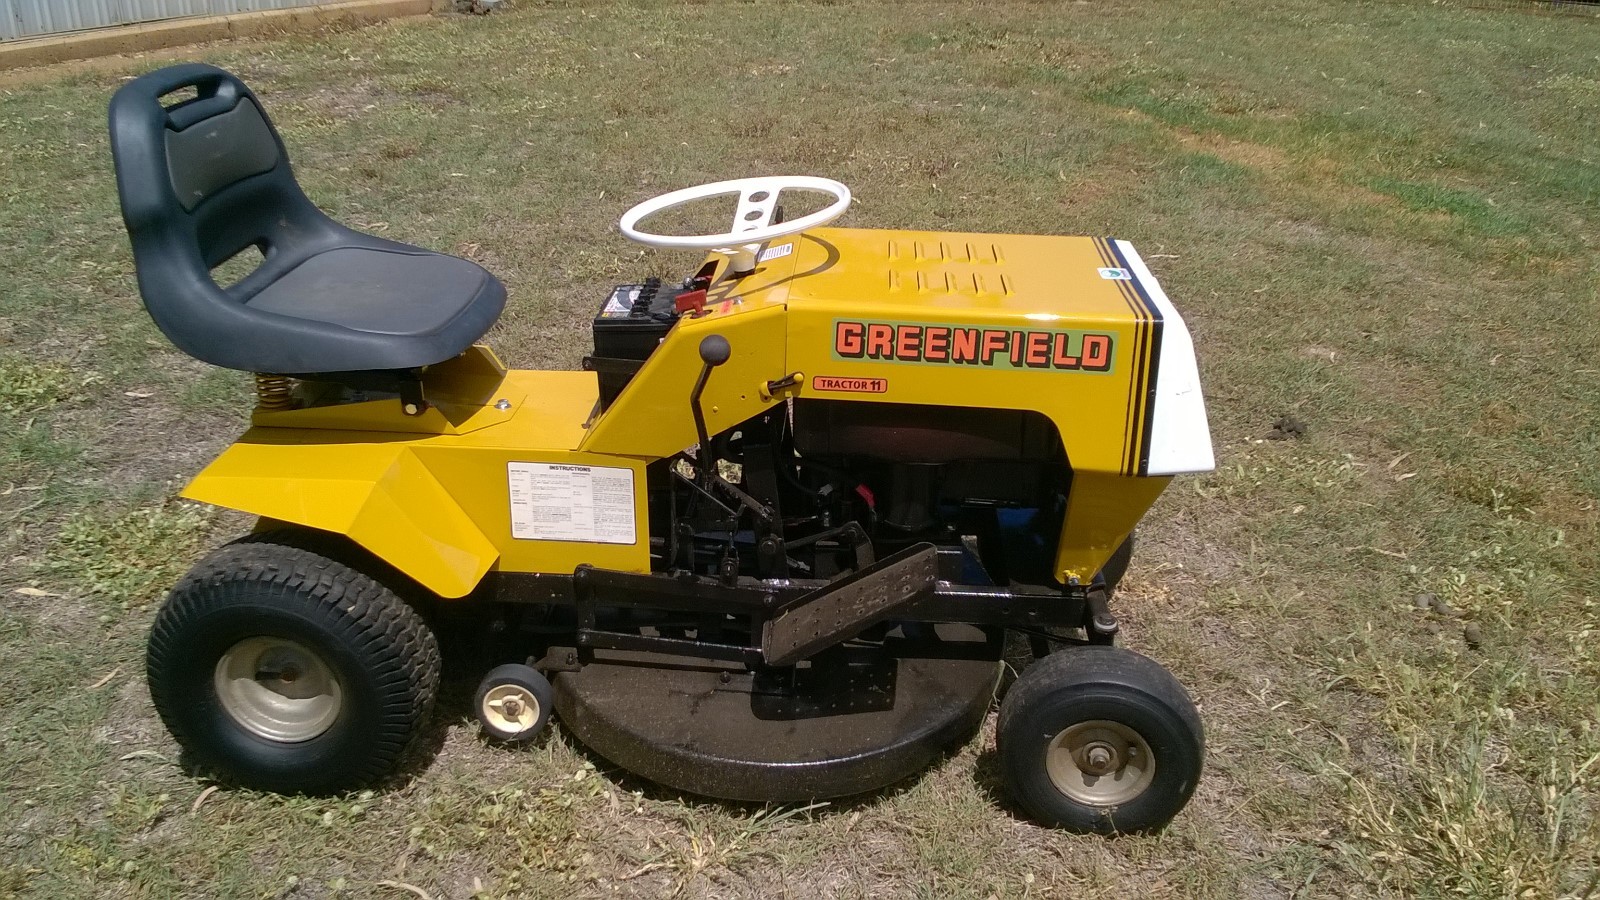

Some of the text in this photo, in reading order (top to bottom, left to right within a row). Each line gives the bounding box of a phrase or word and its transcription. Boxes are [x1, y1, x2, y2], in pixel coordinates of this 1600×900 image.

[835, 321, 1114, 372] GREENFIELD
[821, 379, 881, 391] TRACTOR 11
